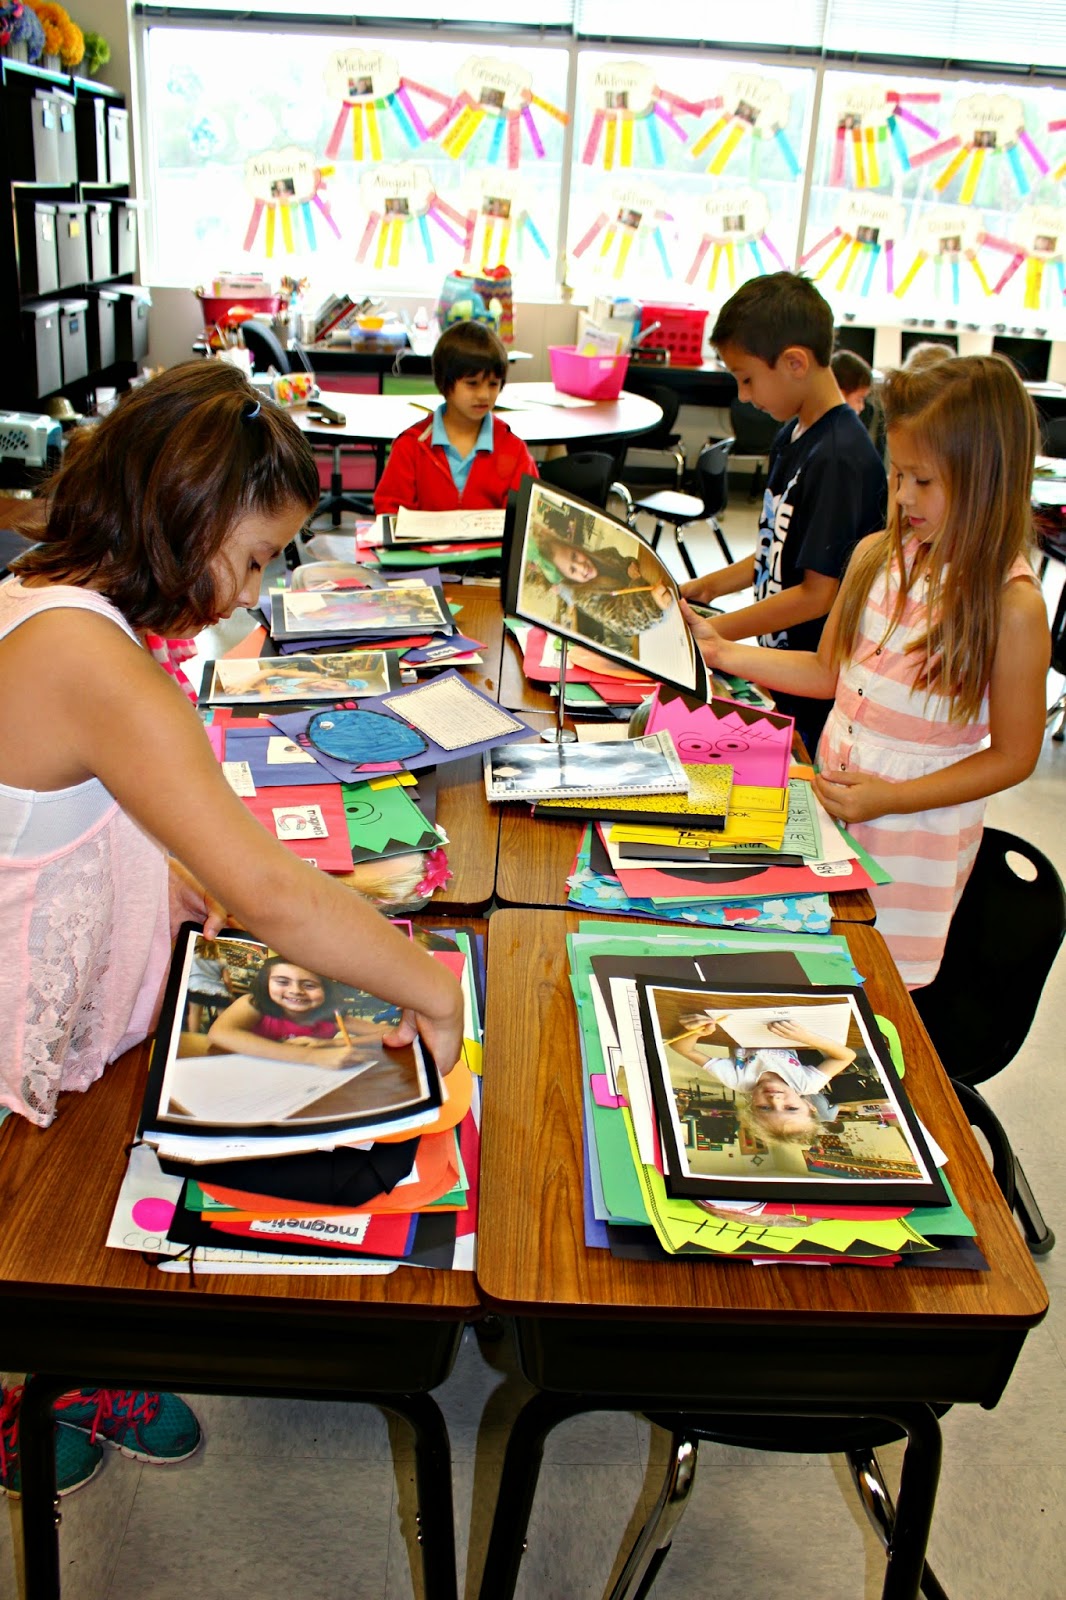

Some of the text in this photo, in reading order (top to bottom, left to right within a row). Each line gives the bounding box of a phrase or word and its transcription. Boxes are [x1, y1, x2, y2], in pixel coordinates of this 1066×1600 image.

[336, 55, 382, 74] Michael
[373, 169, 416, 196] Abigail
[306, 809, 324, 836] magnets
